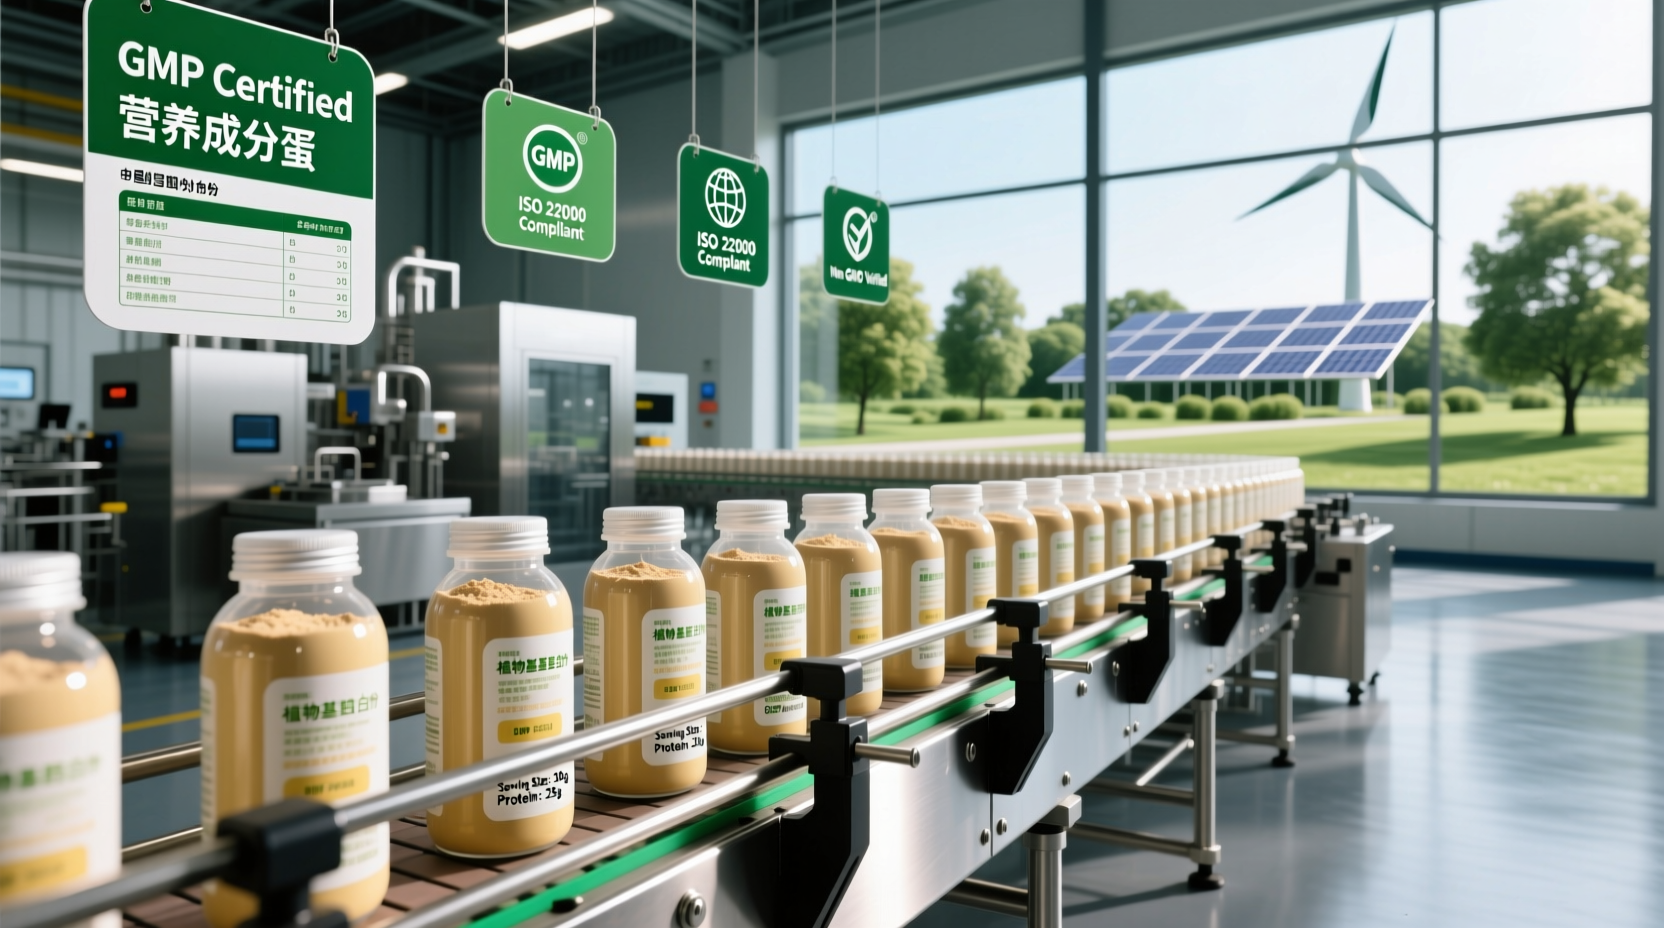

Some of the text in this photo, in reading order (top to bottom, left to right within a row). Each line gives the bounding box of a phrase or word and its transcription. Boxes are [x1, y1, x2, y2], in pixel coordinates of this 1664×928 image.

[118, 41, 353, 123] GMP Certified
[119, 94, 316, 172] 营养成分蛋
[531, 144, 576, 172] GMP
[519, 195, 587, 223] ISO 22000
[697, 231, 757, 257] ISO 22000
